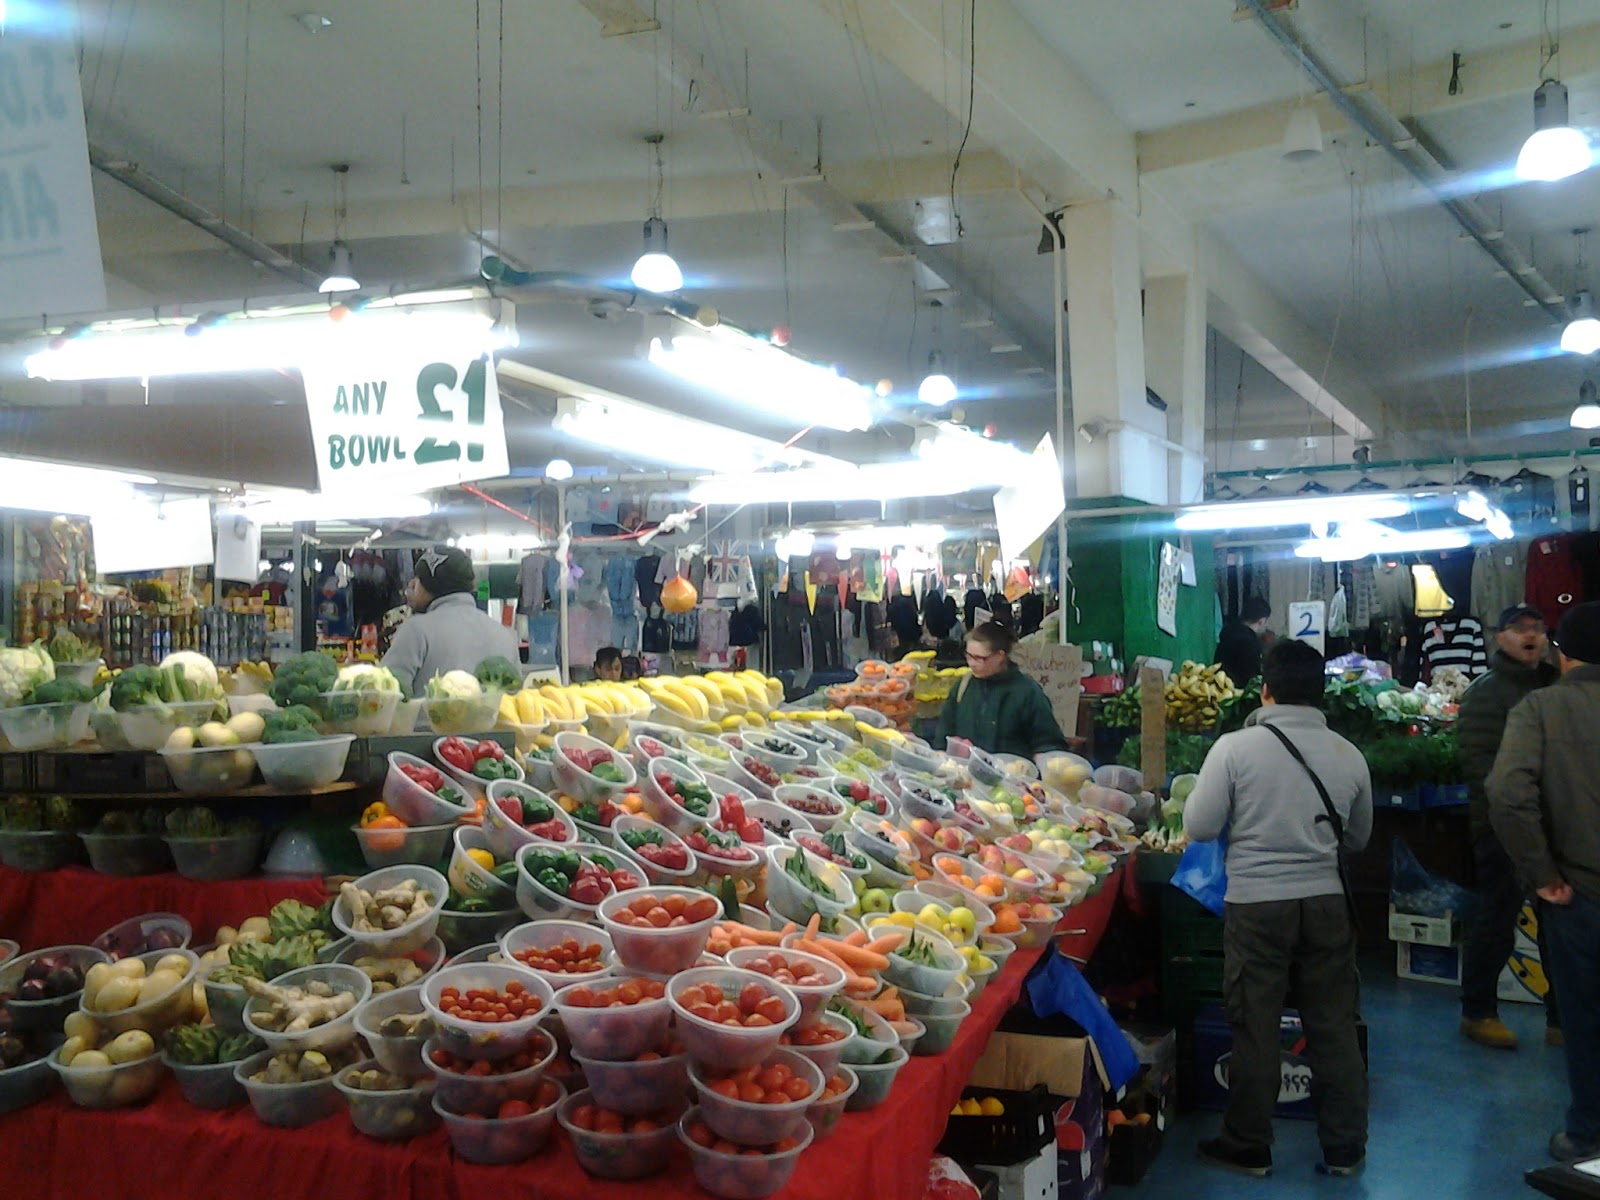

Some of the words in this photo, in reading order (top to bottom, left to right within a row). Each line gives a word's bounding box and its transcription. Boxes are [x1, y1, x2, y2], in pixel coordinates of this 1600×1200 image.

[333, 380, 387, 415] ANY
[414, 359, 486, 465] £1
[328, 434, 406, 470] BOWL
[1296, 611, 1320, 637] 2
